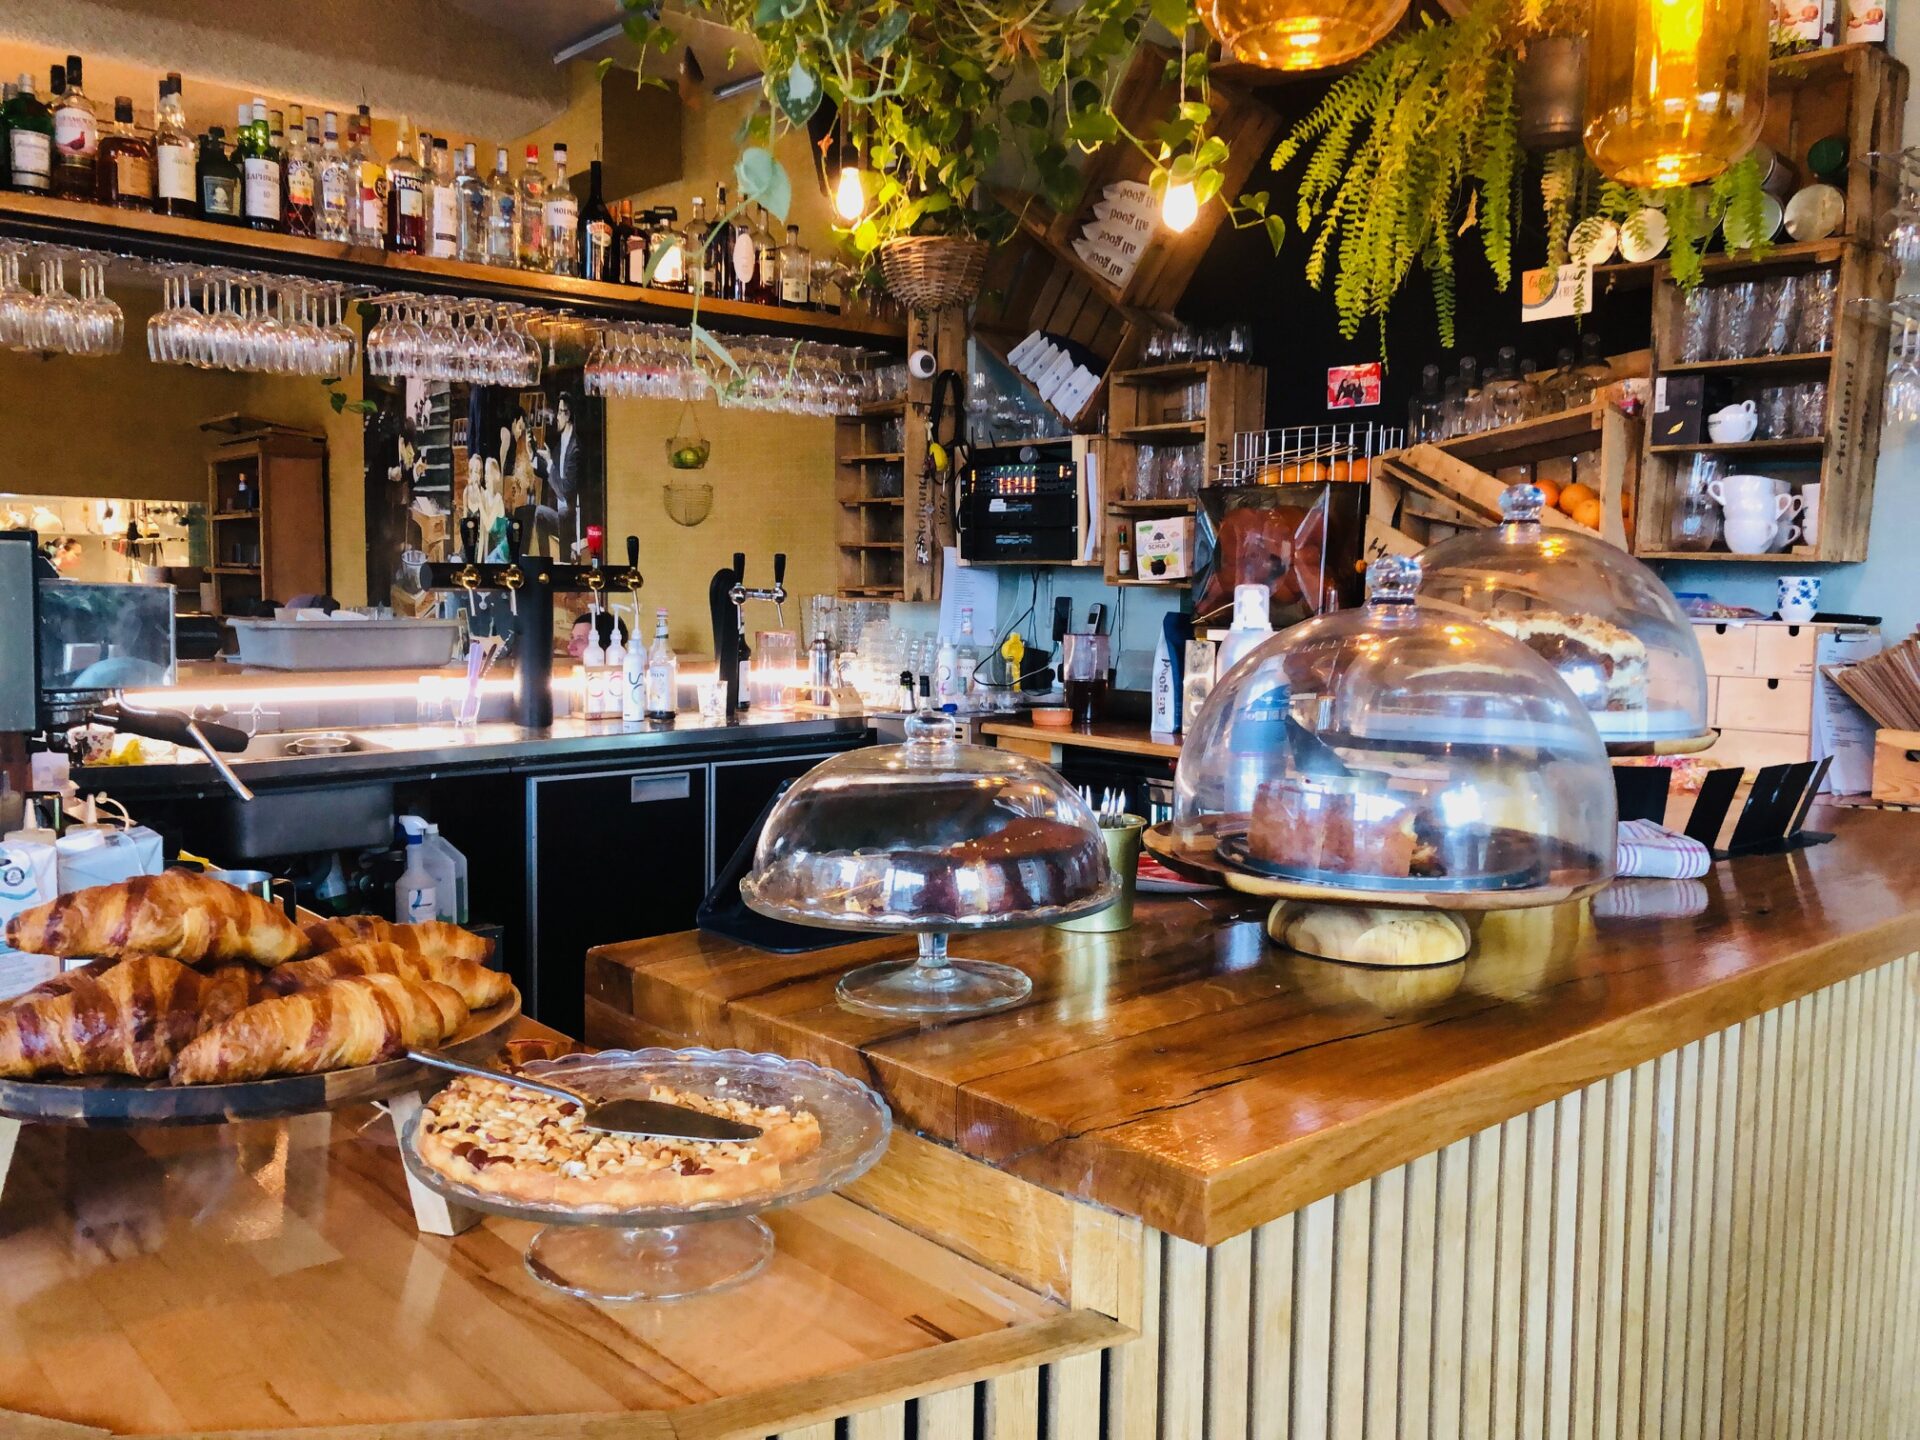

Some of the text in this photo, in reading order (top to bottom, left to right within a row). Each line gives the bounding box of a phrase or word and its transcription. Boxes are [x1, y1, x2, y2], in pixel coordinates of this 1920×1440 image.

[1109, 208, 1149, 231] all good
[1122, 241, 1136, 254] all
[1109, 263, 1123, 276] all
[1159, 658, 1171, 693] good
